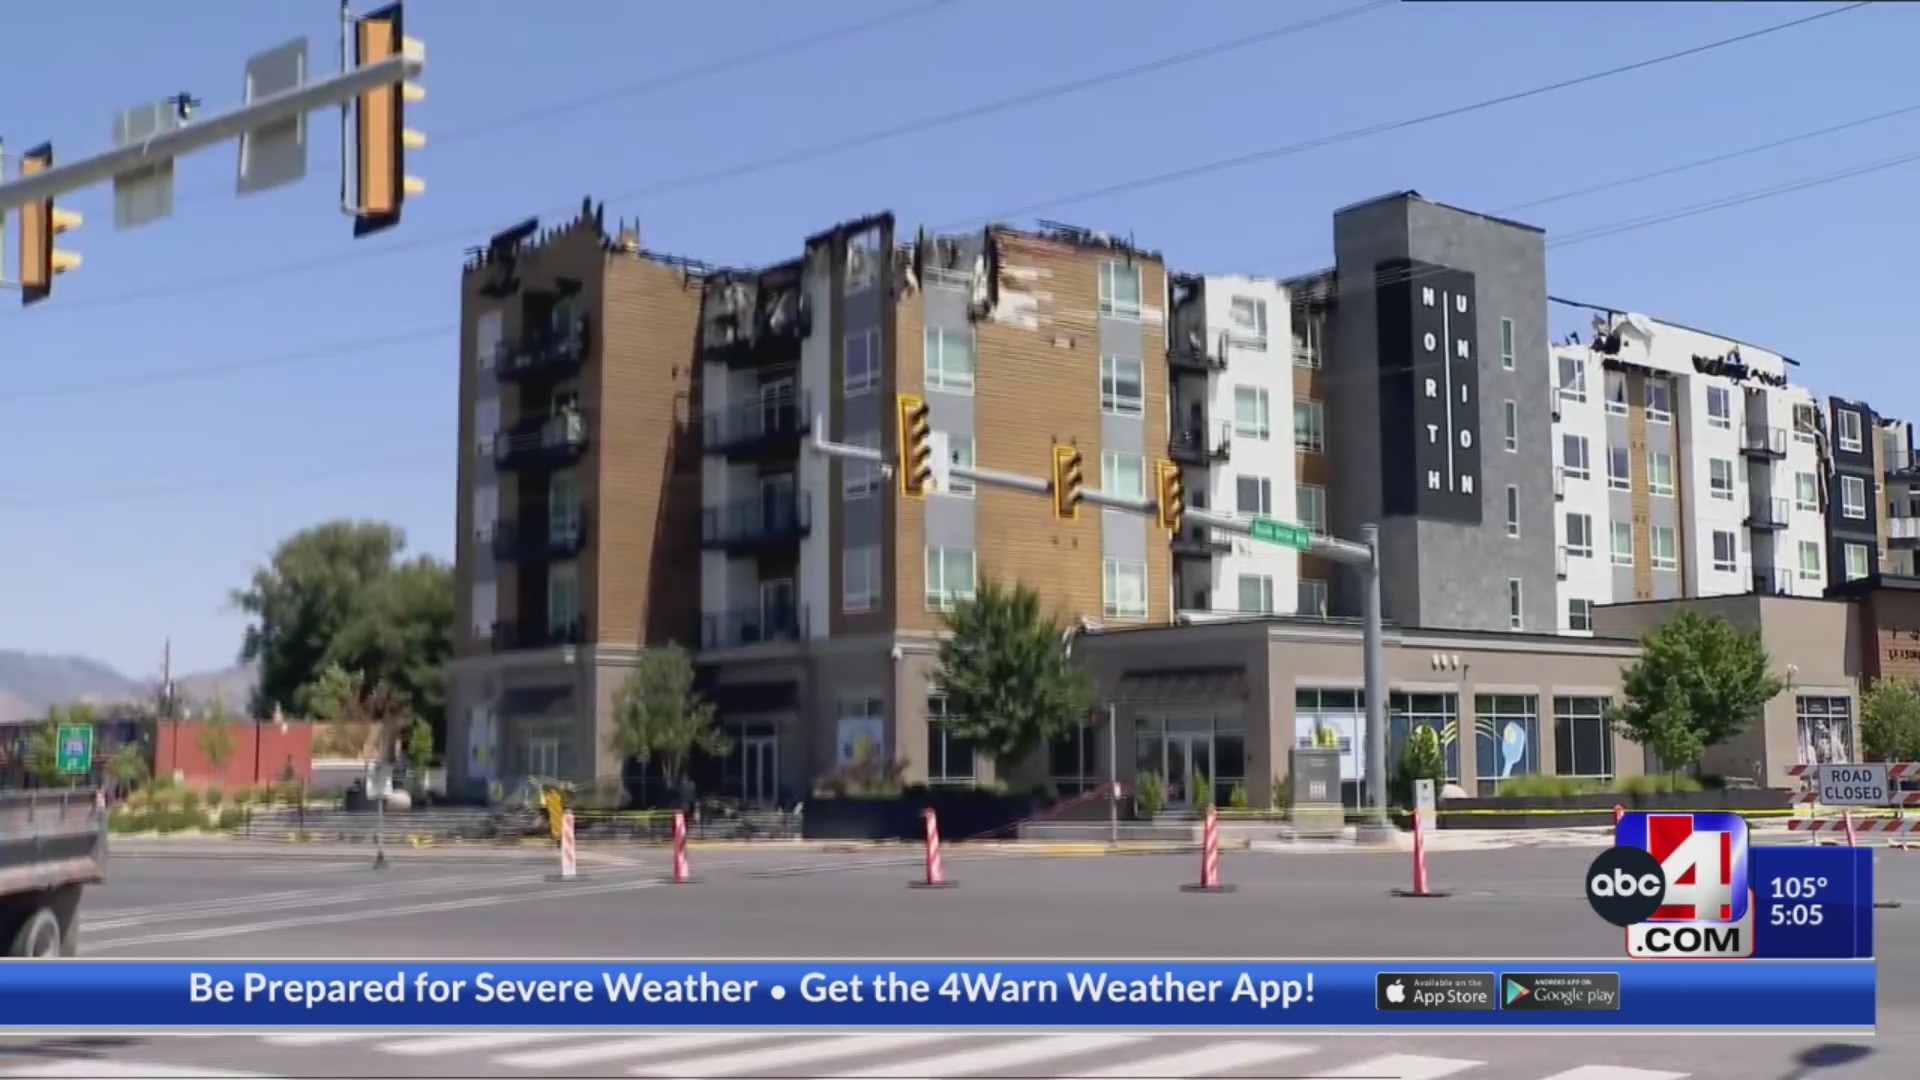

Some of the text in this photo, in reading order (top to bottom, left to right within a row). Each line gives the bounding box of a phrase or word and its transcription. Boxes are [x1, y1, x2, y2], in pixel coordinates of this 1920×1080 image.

[1422, 287, 1440, 490] NORTH
[1456, 294, 1473, 494] UNION
[1825, 786, 1882, 800] CLOSED
[1831, 769, 1872, 782] ROAD
